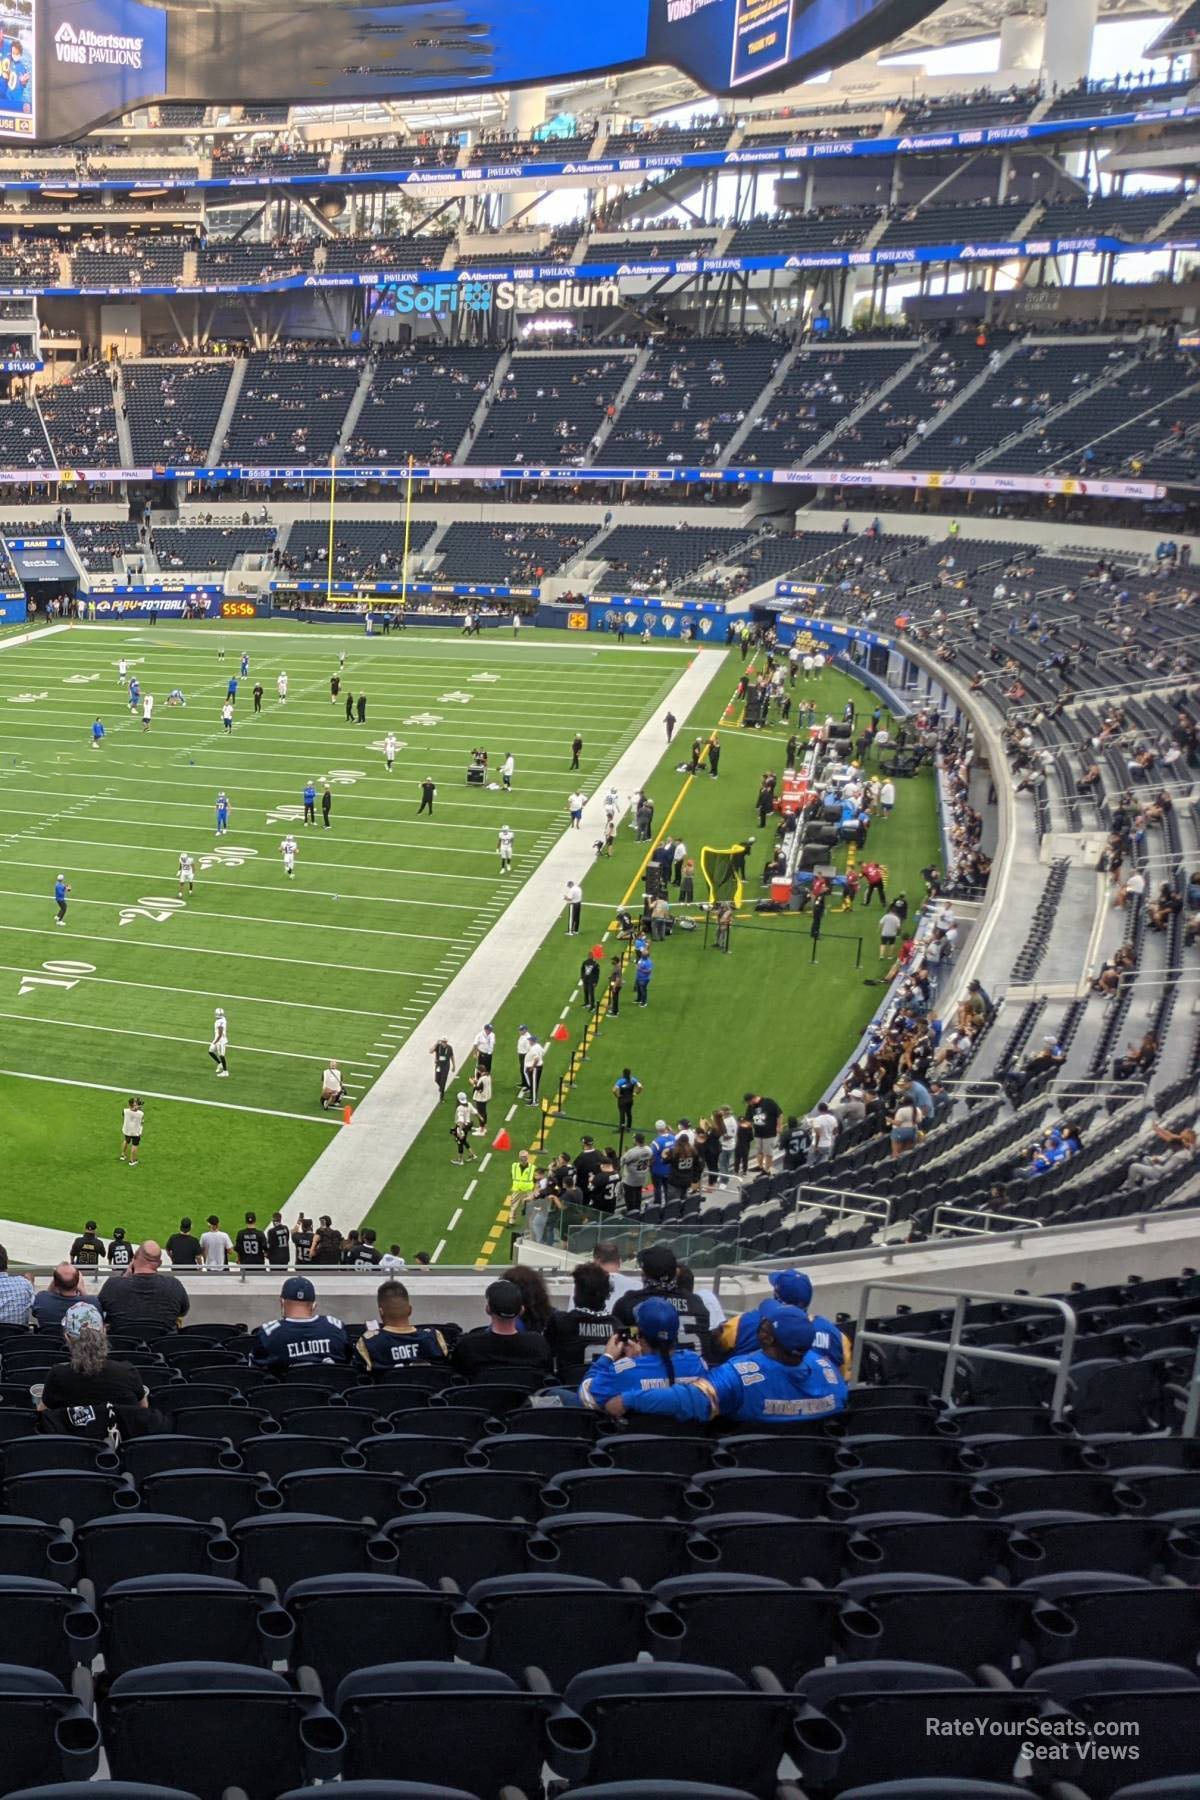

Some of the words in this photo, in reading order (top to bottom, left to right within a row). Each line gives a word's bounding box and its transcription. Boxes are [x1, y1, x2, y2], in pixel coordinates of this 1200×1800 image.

[78, 30, 142, 50] Albertsons
[56, 43, 87, 64] VONS
[88, 48, 142, 69] PAVILIONS
[676, 262, 697, 272] VONS
[358, 274, 378, 284] VONS
[470, 272, 508, 282] Albertsons
[514, 269, 534, 278] VONS
[396, 283, 458, 313] SoFi
[495, 279, 619, 310] Stadium
[8, 362, 36, 372] $11,140
[840, 473, 873, 484] Scores
[223, 604, 254, 616] 55:56
[570, 614, 586, 628] 25
[198, 846, 259, 866] 30
[118, 896, 186, 922] 20
[20, 960, 97, 990] 10
[788, 1138, 807, 1154] 34
[678, 1156, 694, 1170] 28
[244, 1240, 258, 1254] 83
[278, 1236, 288, 1248] 11
[114, 1250, 128, 1264] 28
[578, 1322, 614, 1336] MARIOTA
[287, 1338, 332, 1358] ELLIOTT
[390, 1344, 420, 1360] GOFF
